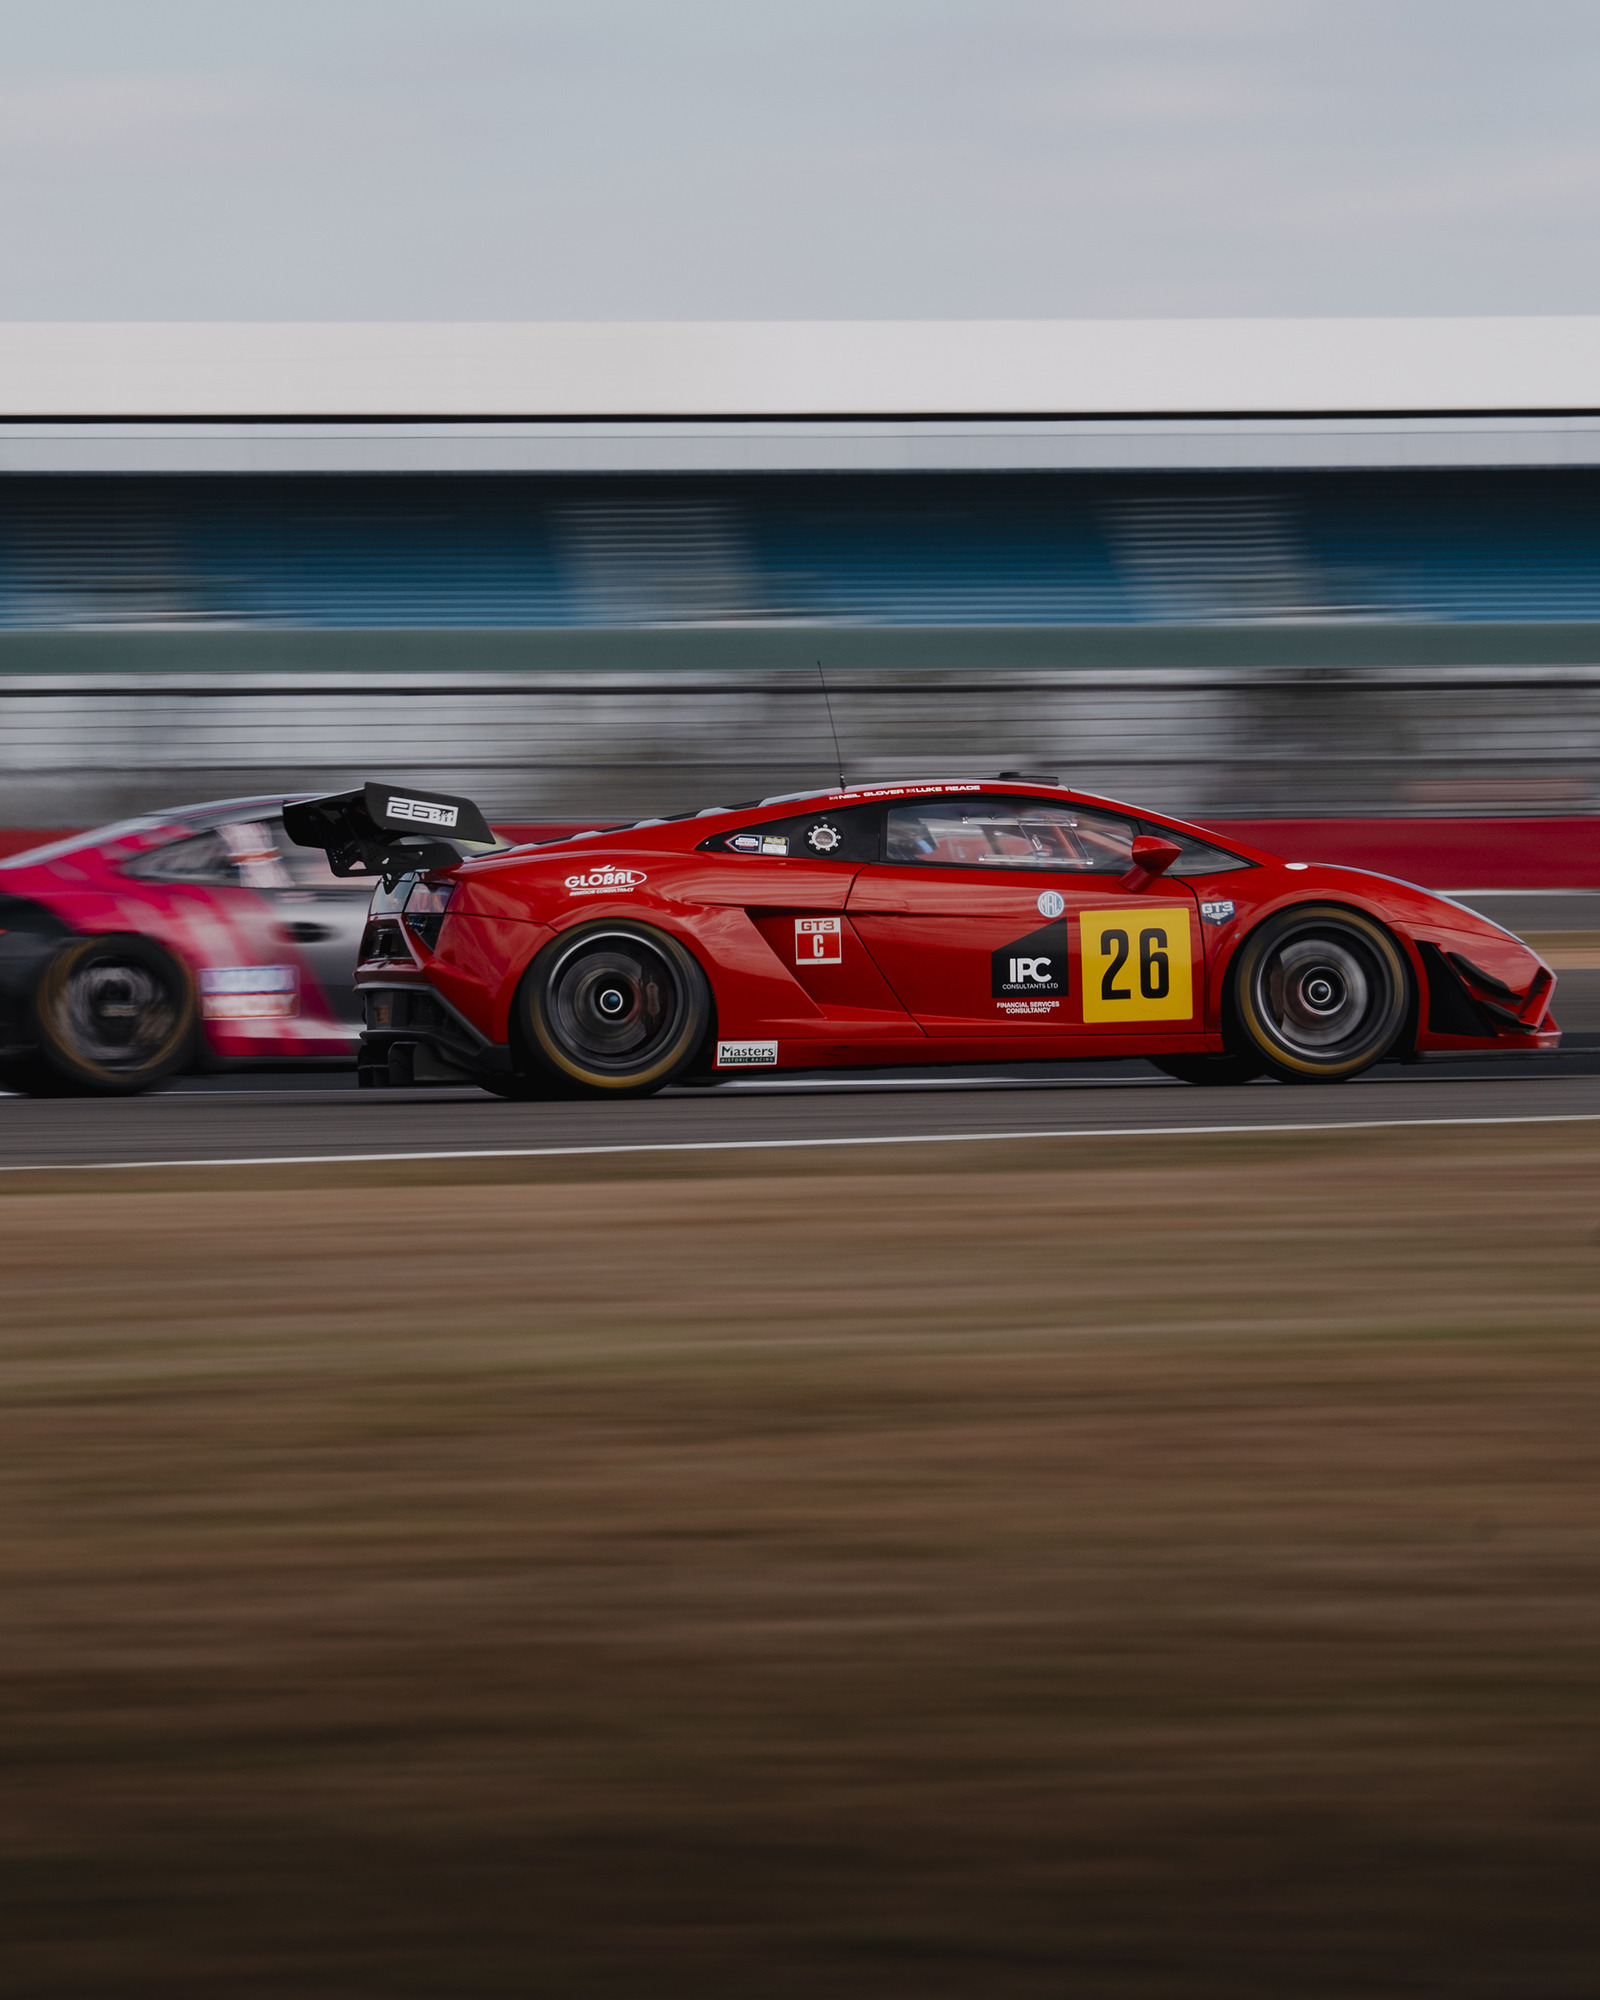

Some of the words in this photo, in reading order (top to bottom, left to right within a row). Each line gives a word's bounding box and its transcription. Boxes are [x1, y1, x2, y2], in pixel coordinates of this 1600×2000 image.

[863, 789, 904, 797] GLOVER
[564, 872, 636, 888] GLOBAL
[1201, 900, 1234, 914] GT3
[801, 920, 835, 931] GT3
[813, 934, 824, 957] C
[1009, 957, 1052, 983] IPC
[1101, 928, 1170, 1000] 26
[721, 1045, 774, 1057] Masters
